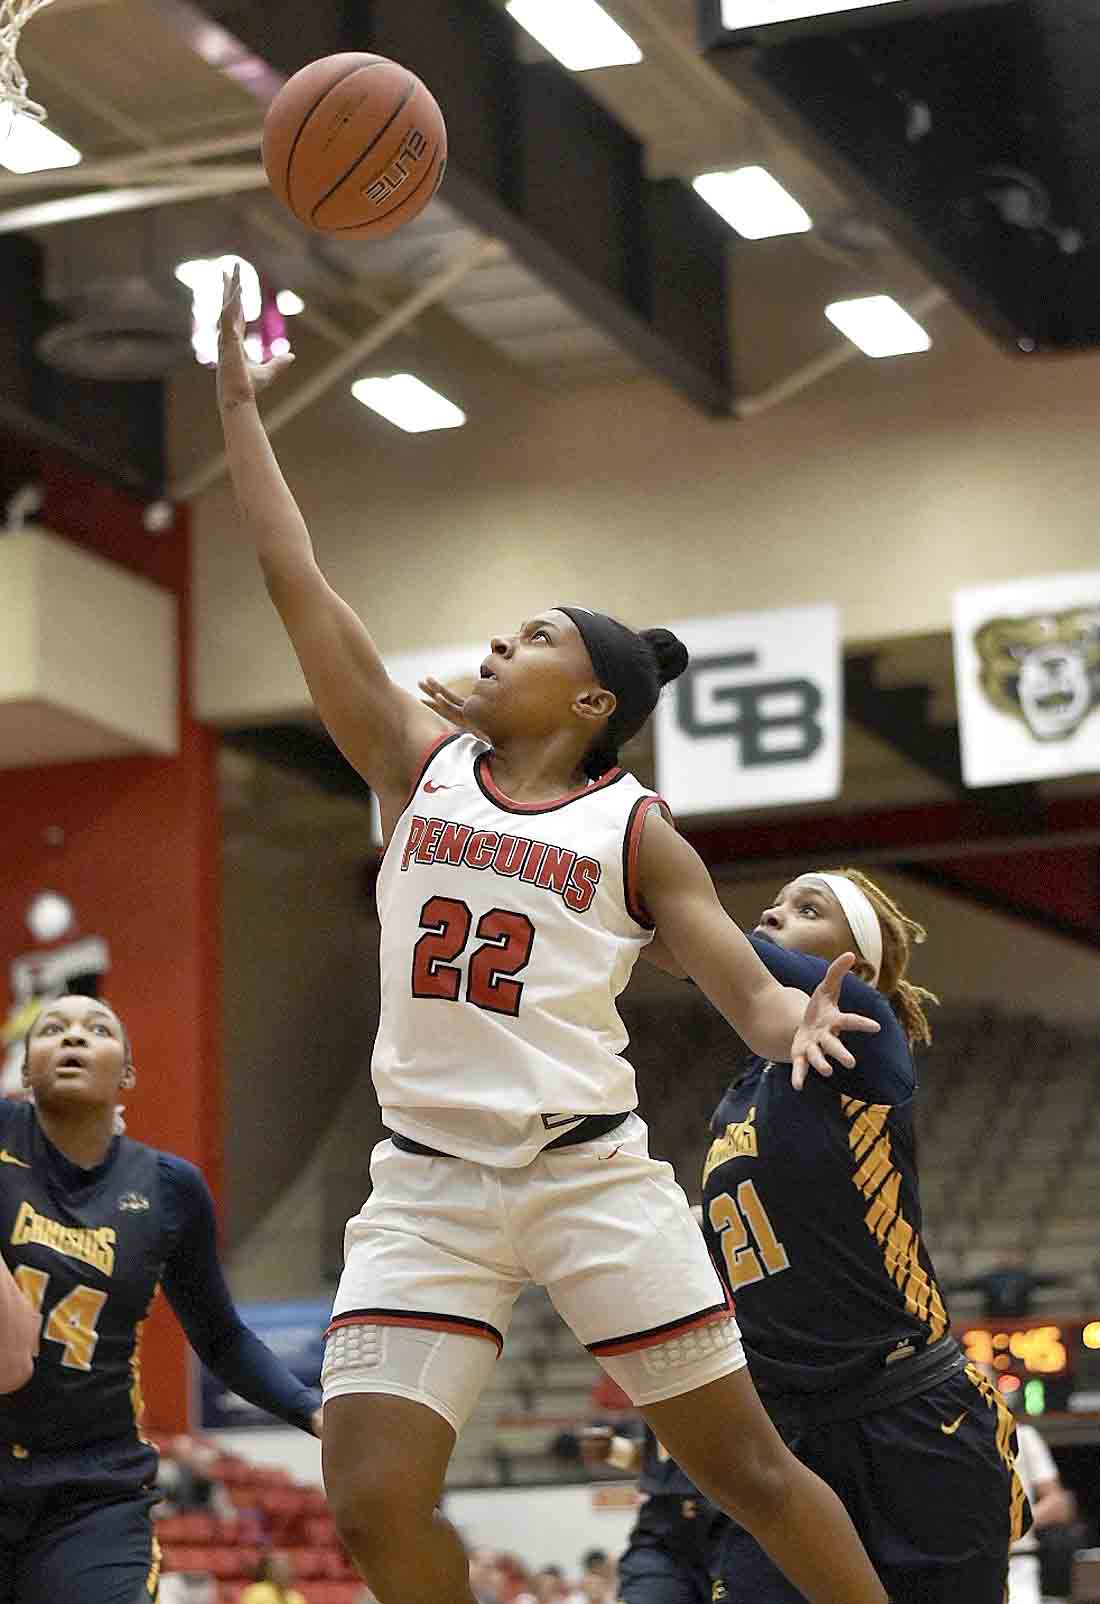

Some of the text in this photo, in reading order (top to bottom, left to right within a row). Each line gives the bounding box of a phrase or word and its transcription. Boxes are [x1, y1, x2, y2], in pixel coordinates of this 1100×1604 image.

[401, 815, 602, 912] PENGUINS
[411, 895, 536, 1018] 22
[709, 1179, 791, 1292] 21
